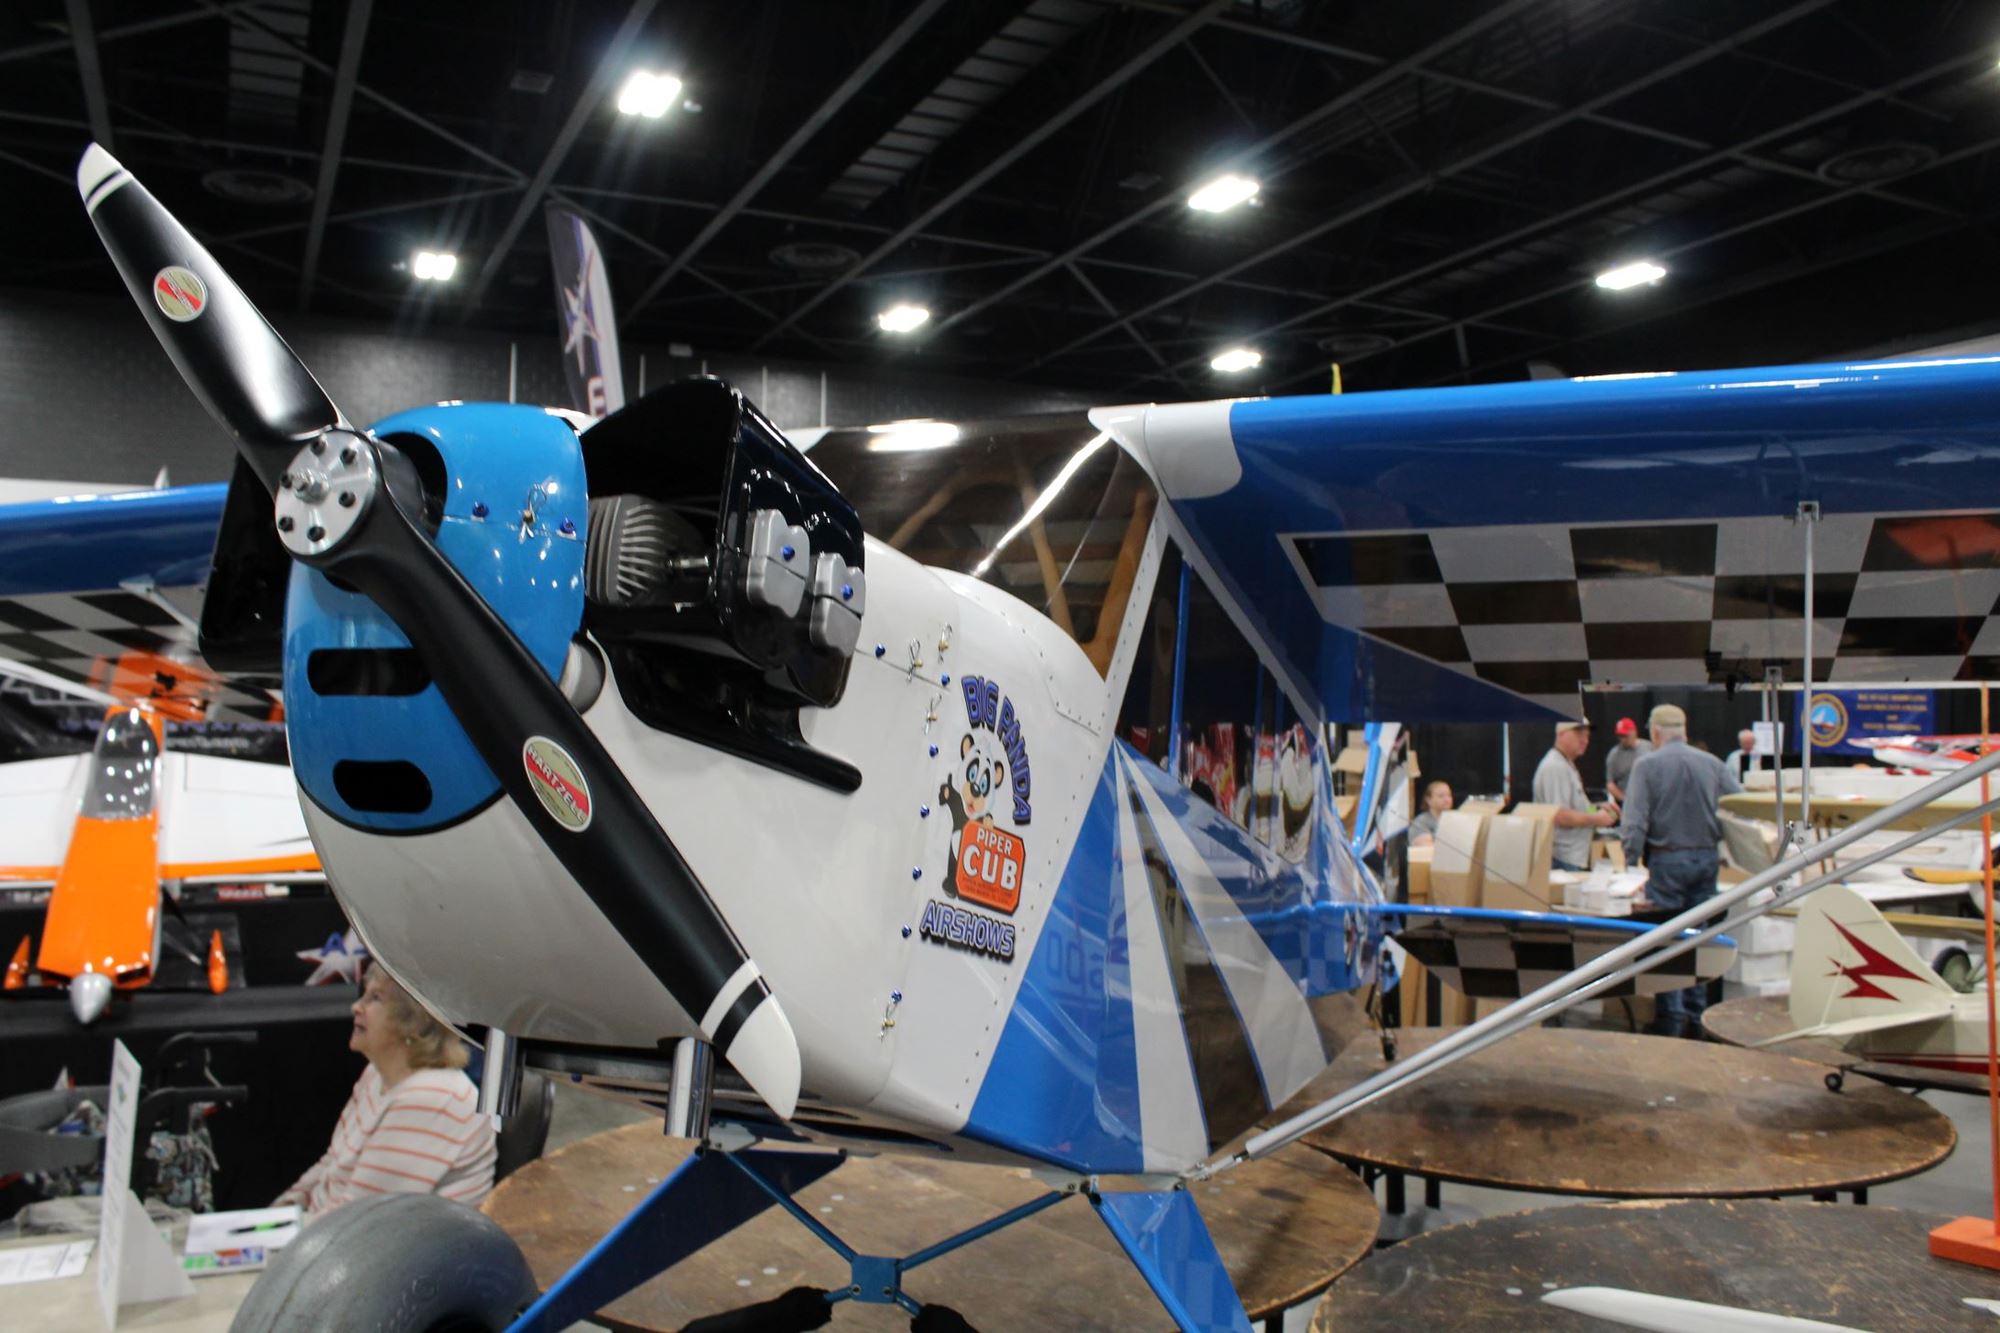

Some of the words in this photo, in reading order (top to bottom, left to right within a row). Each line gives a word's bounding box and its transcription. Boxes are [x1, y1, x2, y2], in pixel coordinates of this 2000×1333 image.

[961, 675, 999, 732] BIG
[997, 696, 1031, 825] PANDA
[525, 743, 587, 824] HARTZELL
[963, 844, 1018, 890] CUB
[976, 827, 1013, 856] PIPER
[920, 900, 1015, 962] AIRSHOWS
